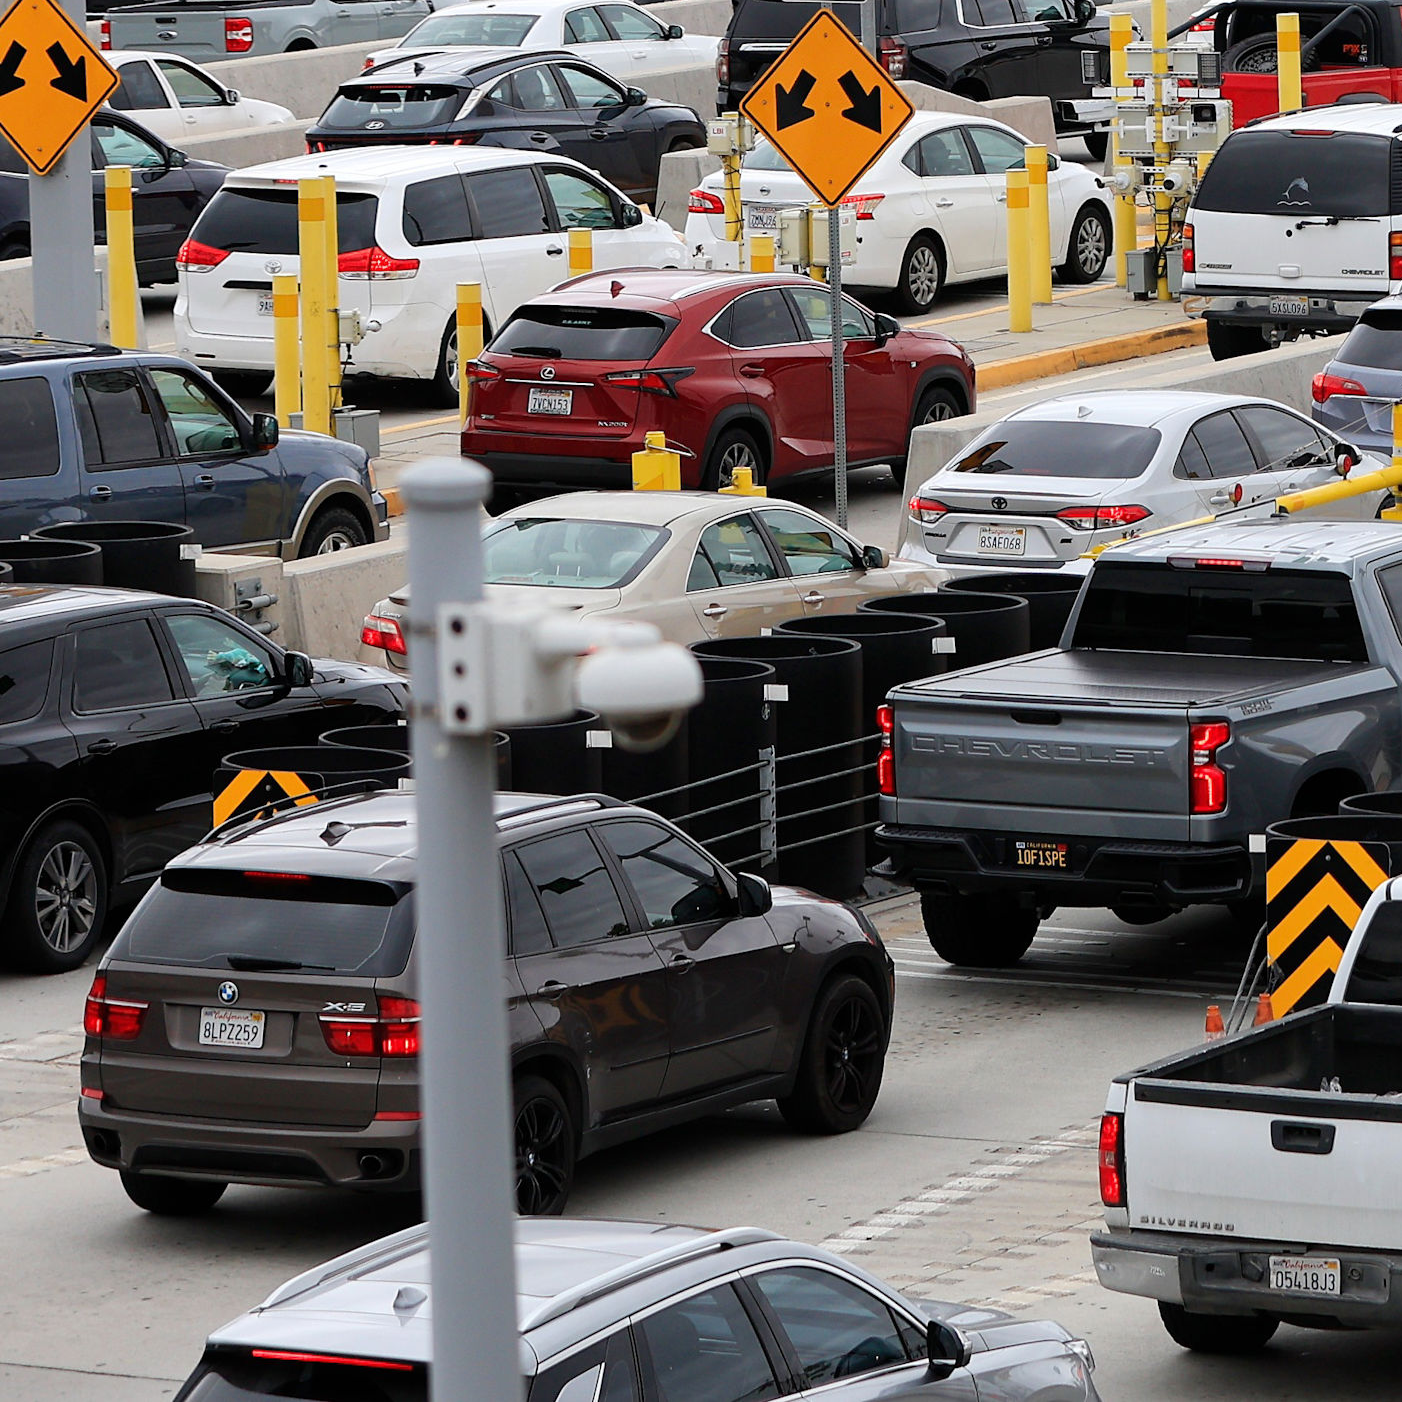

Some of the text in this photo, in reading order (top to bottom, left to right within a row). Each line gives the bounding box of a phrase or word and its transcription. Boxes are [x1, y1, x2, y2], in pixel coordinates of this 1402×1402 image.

[1341, 268, 1385, 276] CHEVROLET
[1271, 301, 1307, 315] 5XSL096
[980, 535, 1021, 551] 8SAE068
[911, 734, 1165, 766] CHEVROLET
[203, 1021, 259, 1042] 8LPZ259
[1139, 1212, 1236, 1232] SILVERADO
